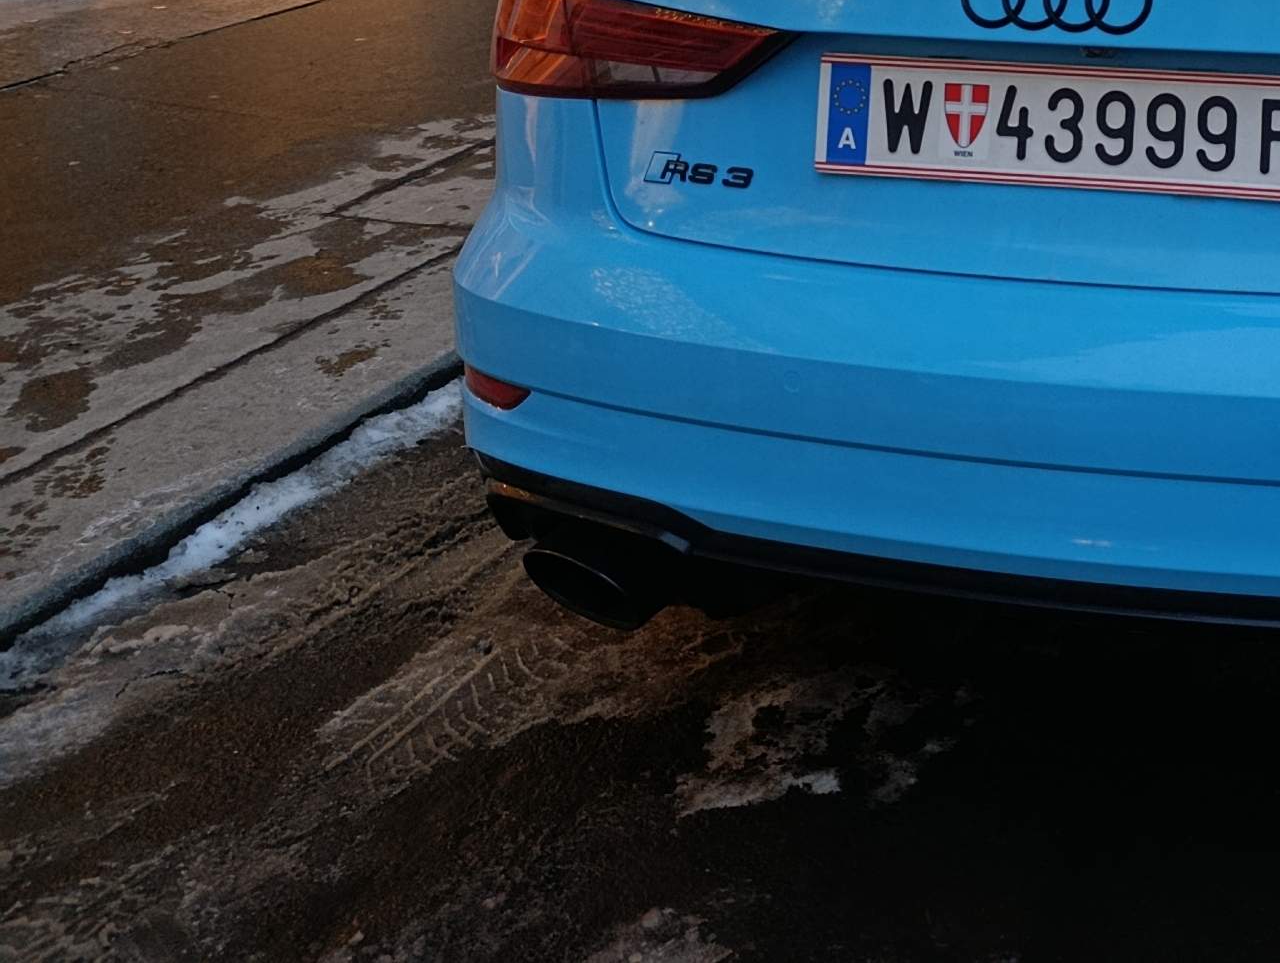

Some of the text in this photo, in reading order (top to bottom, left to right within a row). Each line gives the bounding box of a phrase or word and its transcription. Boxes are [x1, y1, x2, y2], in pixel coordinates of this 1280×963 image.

[883, 78, 933, 155] W
[837, 127, 856, 150] A
[660, 160, 754, 189] RS 3
